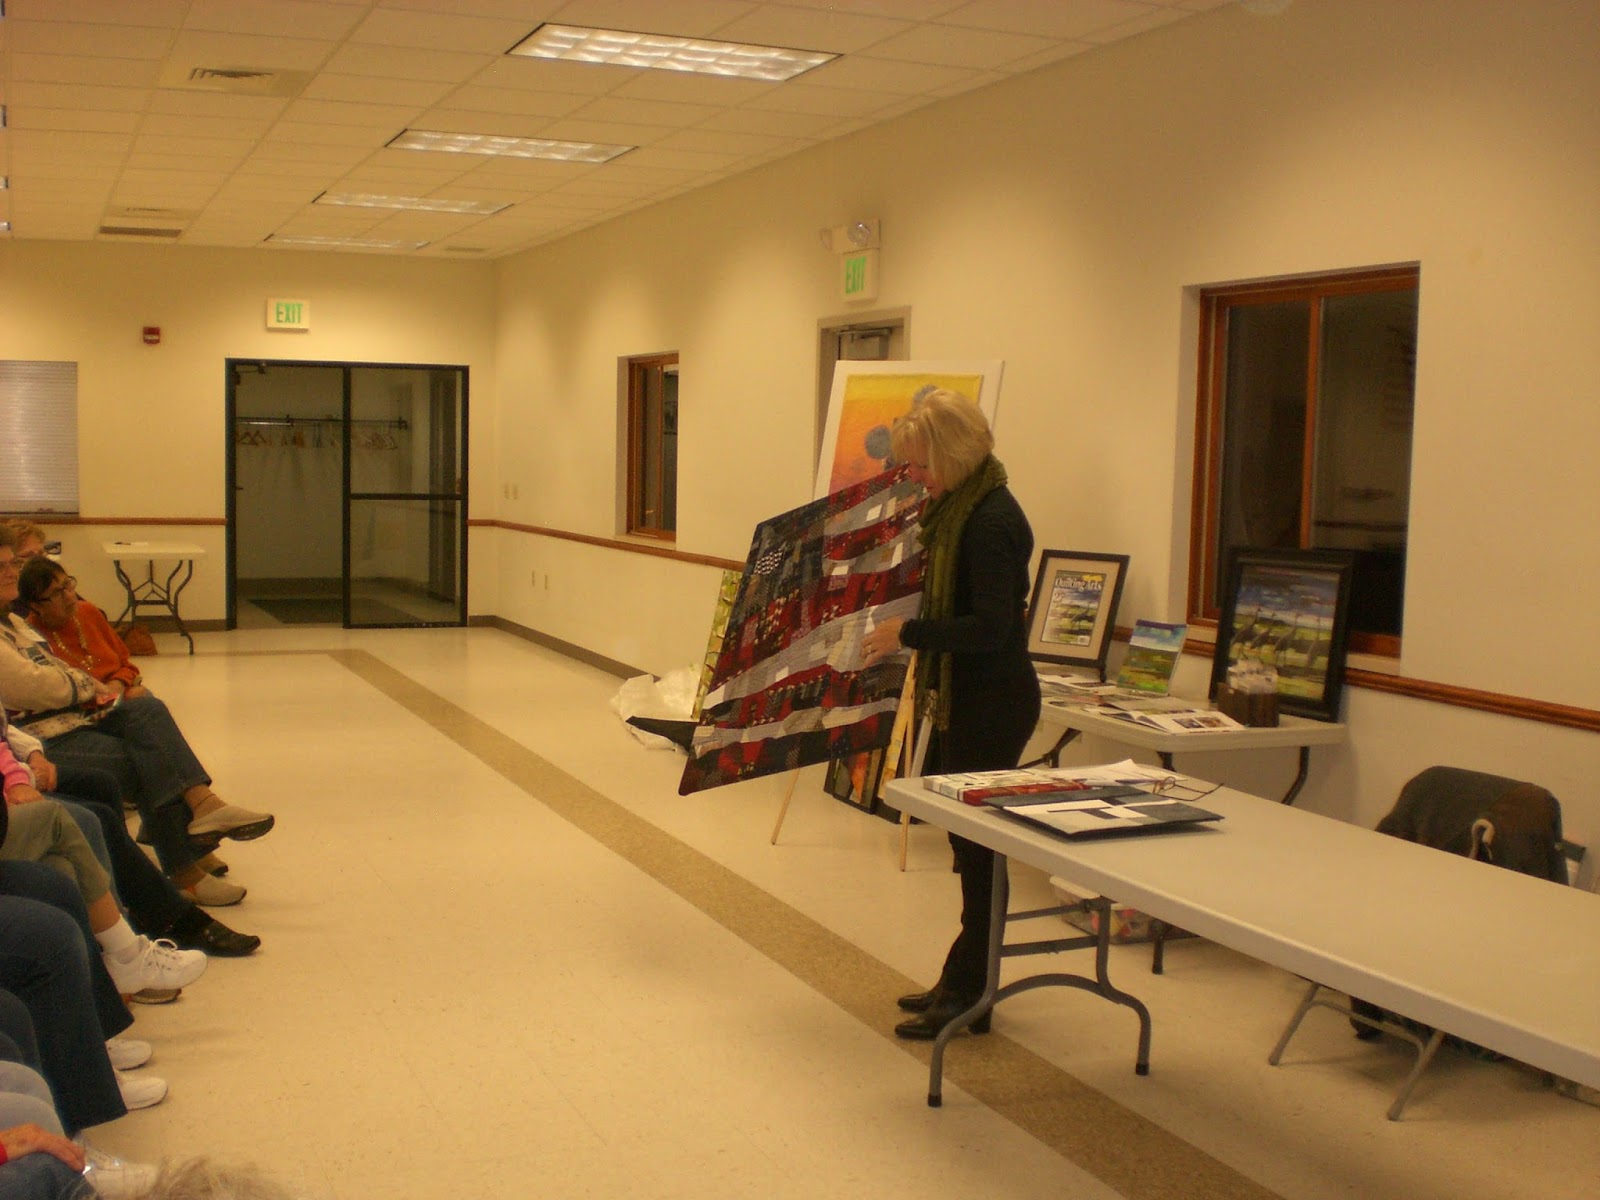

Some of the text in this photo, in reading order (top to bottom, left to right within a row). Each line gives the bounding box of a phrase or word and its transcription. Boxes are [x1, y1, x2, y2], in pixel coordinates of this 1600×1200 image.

[846, 256, 867, 295] EXIT
[276, 303, 303, 323] EXIT
[1055, 577, 1085, 592] Quilting
[1085, 579, 1103, 591] Arts
